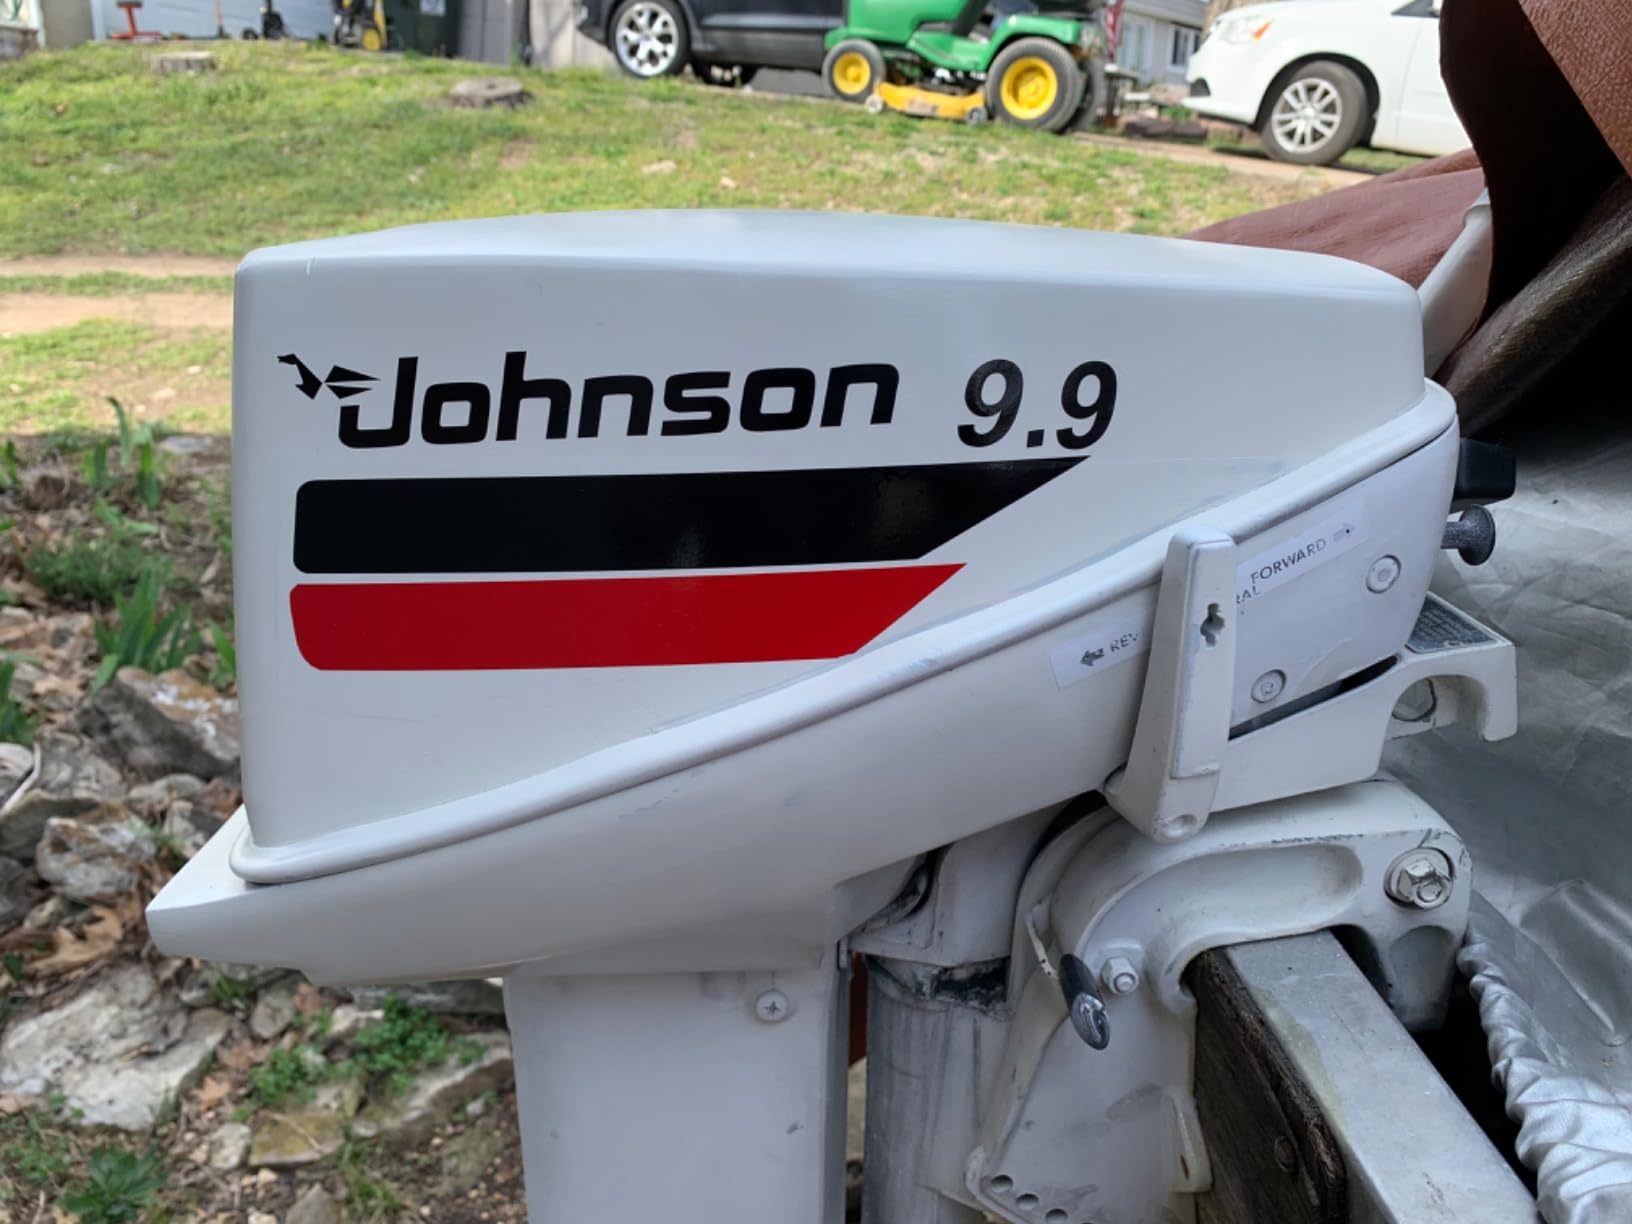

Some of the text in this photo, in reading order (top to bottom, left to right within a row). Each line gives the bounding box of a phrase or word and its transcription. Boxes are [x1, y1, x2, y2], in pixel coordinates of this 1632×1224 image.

[339, 351, 1118, 450] Johnson 9.9
[1250, 538, 1327, 584] FORWARD
